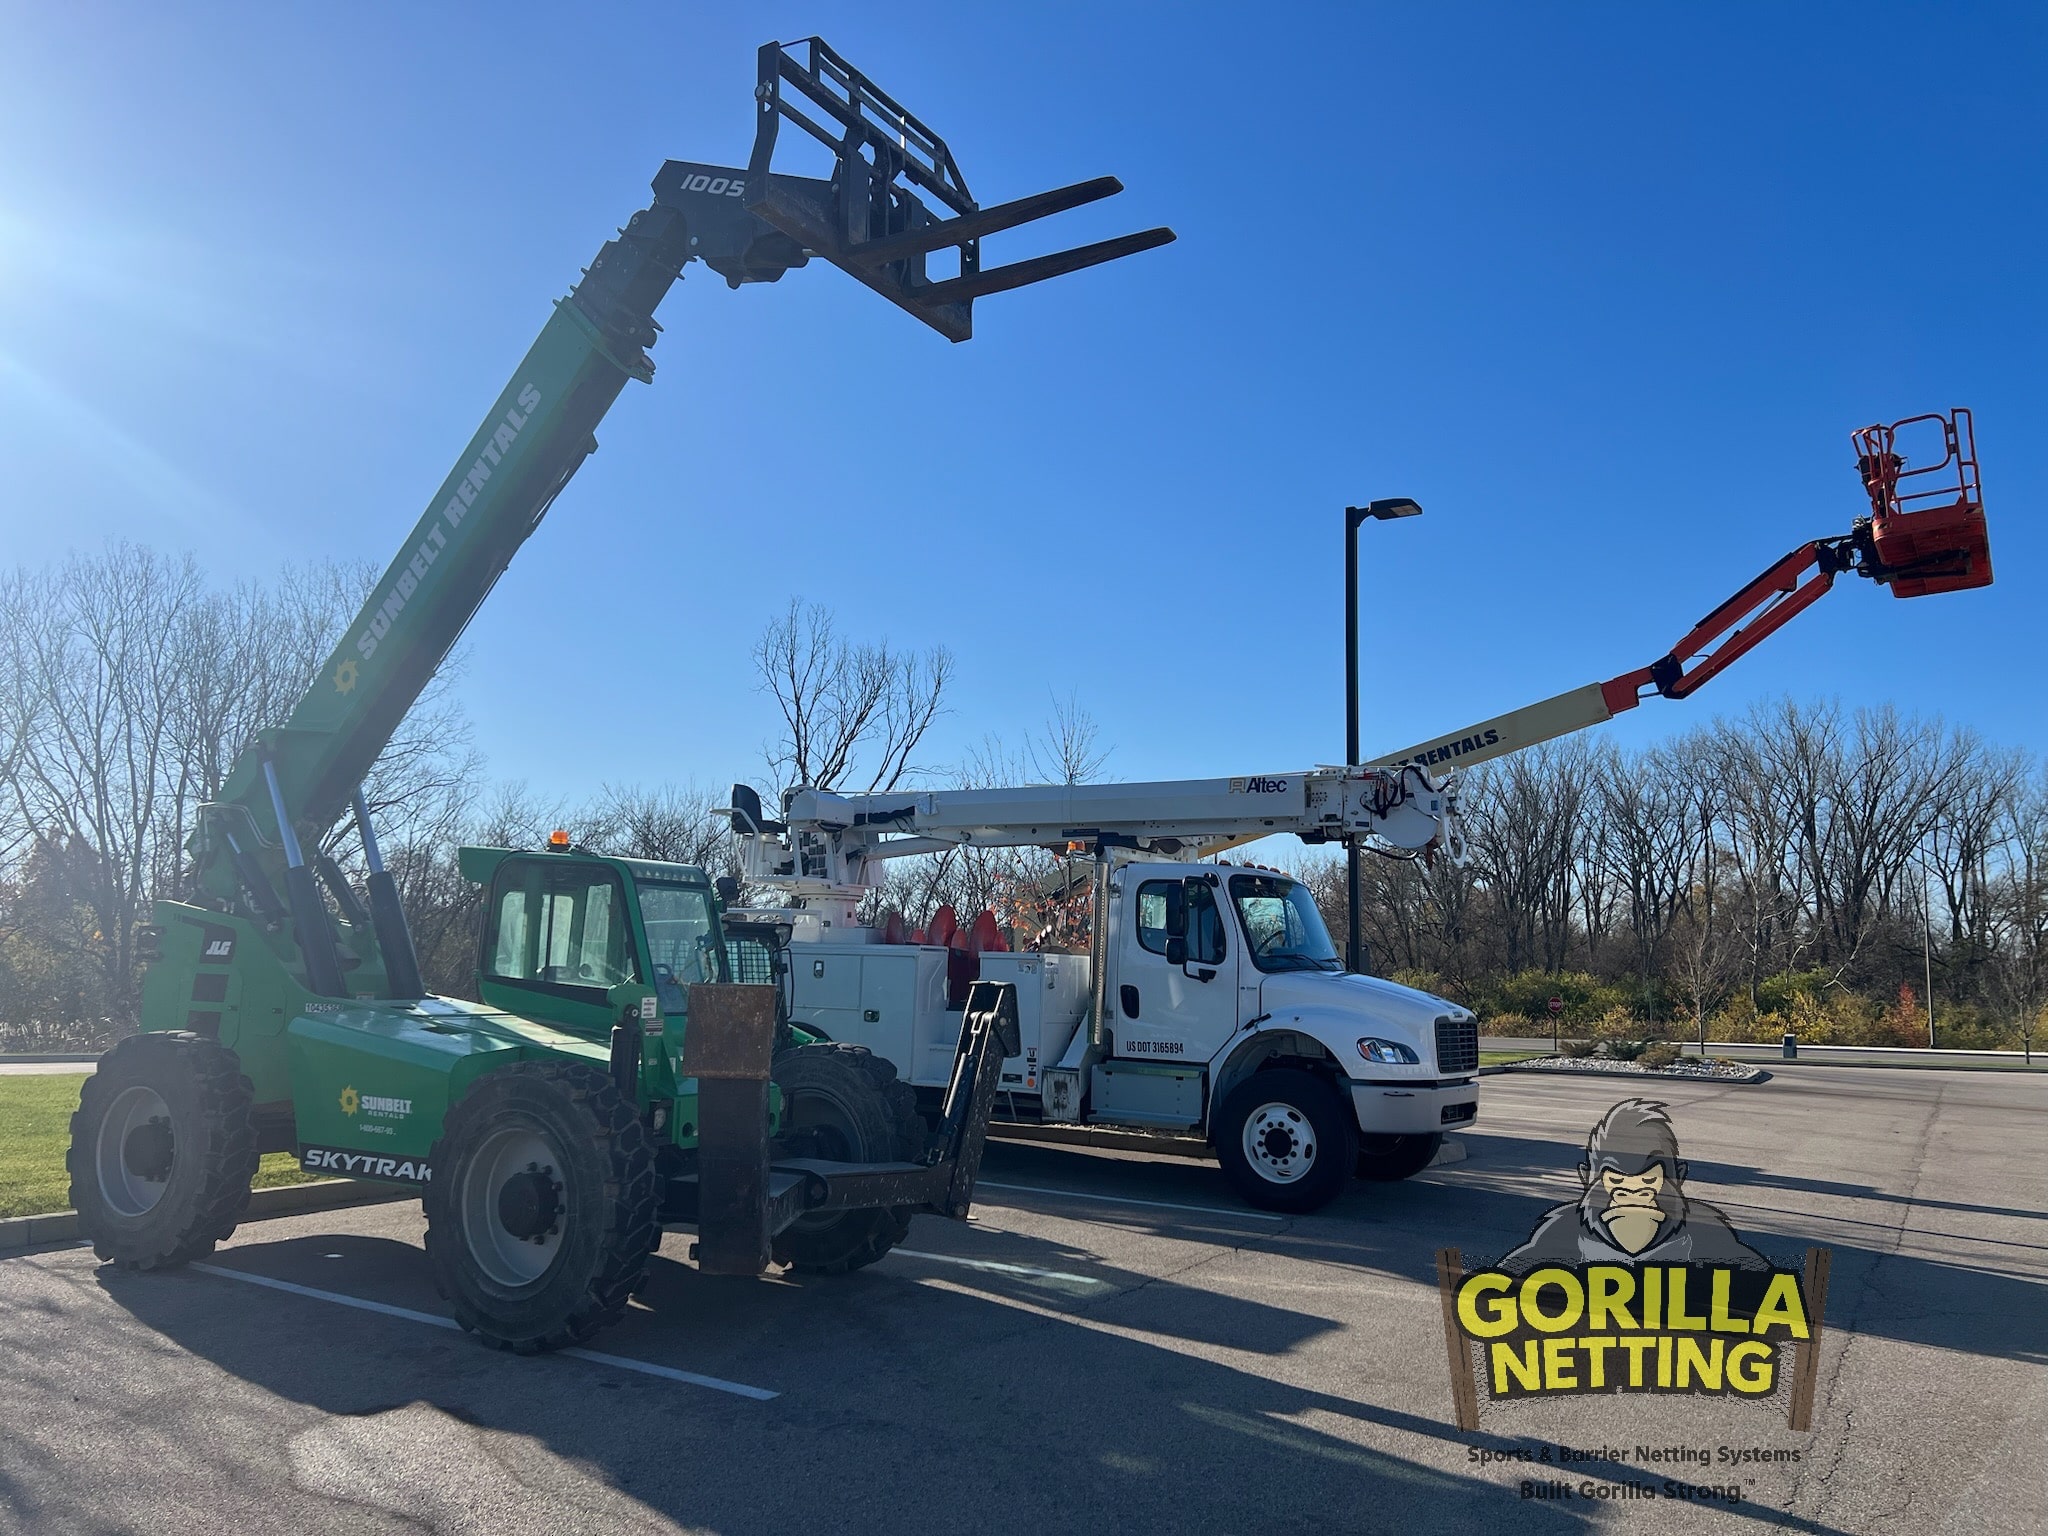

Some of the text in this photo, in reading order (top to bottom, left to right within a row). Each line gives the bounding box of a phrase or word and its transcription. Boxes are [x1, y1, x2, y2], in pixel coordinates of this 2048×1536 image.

[357, 382, 541, 660] SUNBELT RENTALS
[1414, 729, 1499, 767] RENTALS
[1246, 776, 1288, 793] Altec
[206, 941, 232, 955] JLG
[1126, 1041, 1183, 1054] US DOT 3165894
[361, 1095, 411, 1114] SUNBELT
[367, 1110, 404, 1119] RENTALS
